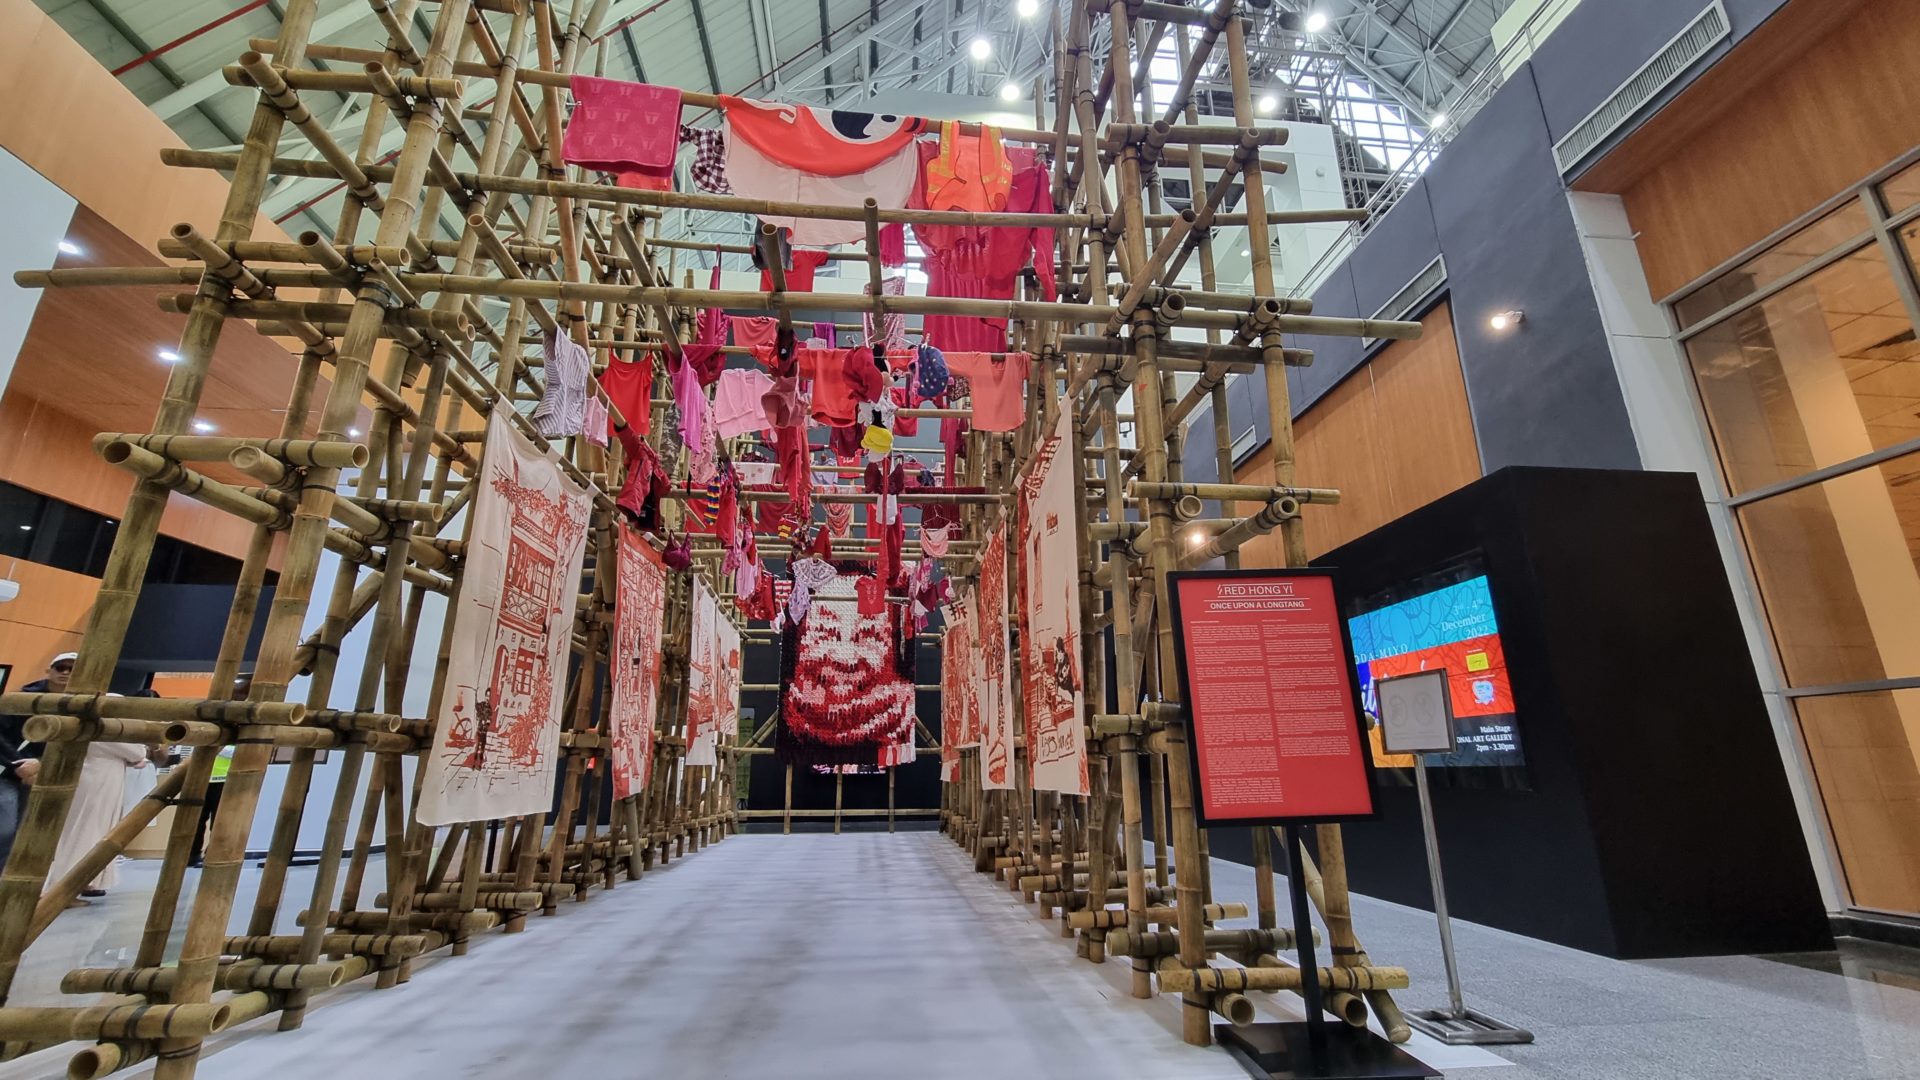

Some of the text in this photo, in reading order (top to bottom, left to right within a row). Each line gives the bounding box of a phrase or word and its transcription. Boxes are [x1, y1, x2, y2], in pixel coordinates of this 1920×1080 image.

[1224, 585, 1293, 595] RED HONG YI
[1210, 602, 1232, 610] ONCE
[1263, 600, 1305, 609] LONGTANG
[948, 601, 968, 622] 拆
[1441, 614, 1486, 632] December
[1495, 725, 1511, 733] Stage
[1485, 733, 1512, 742] GALLERY
[1476, 744, 1490, 752] 2pm
[1492, 743, 1516, 752] 3.30pm
